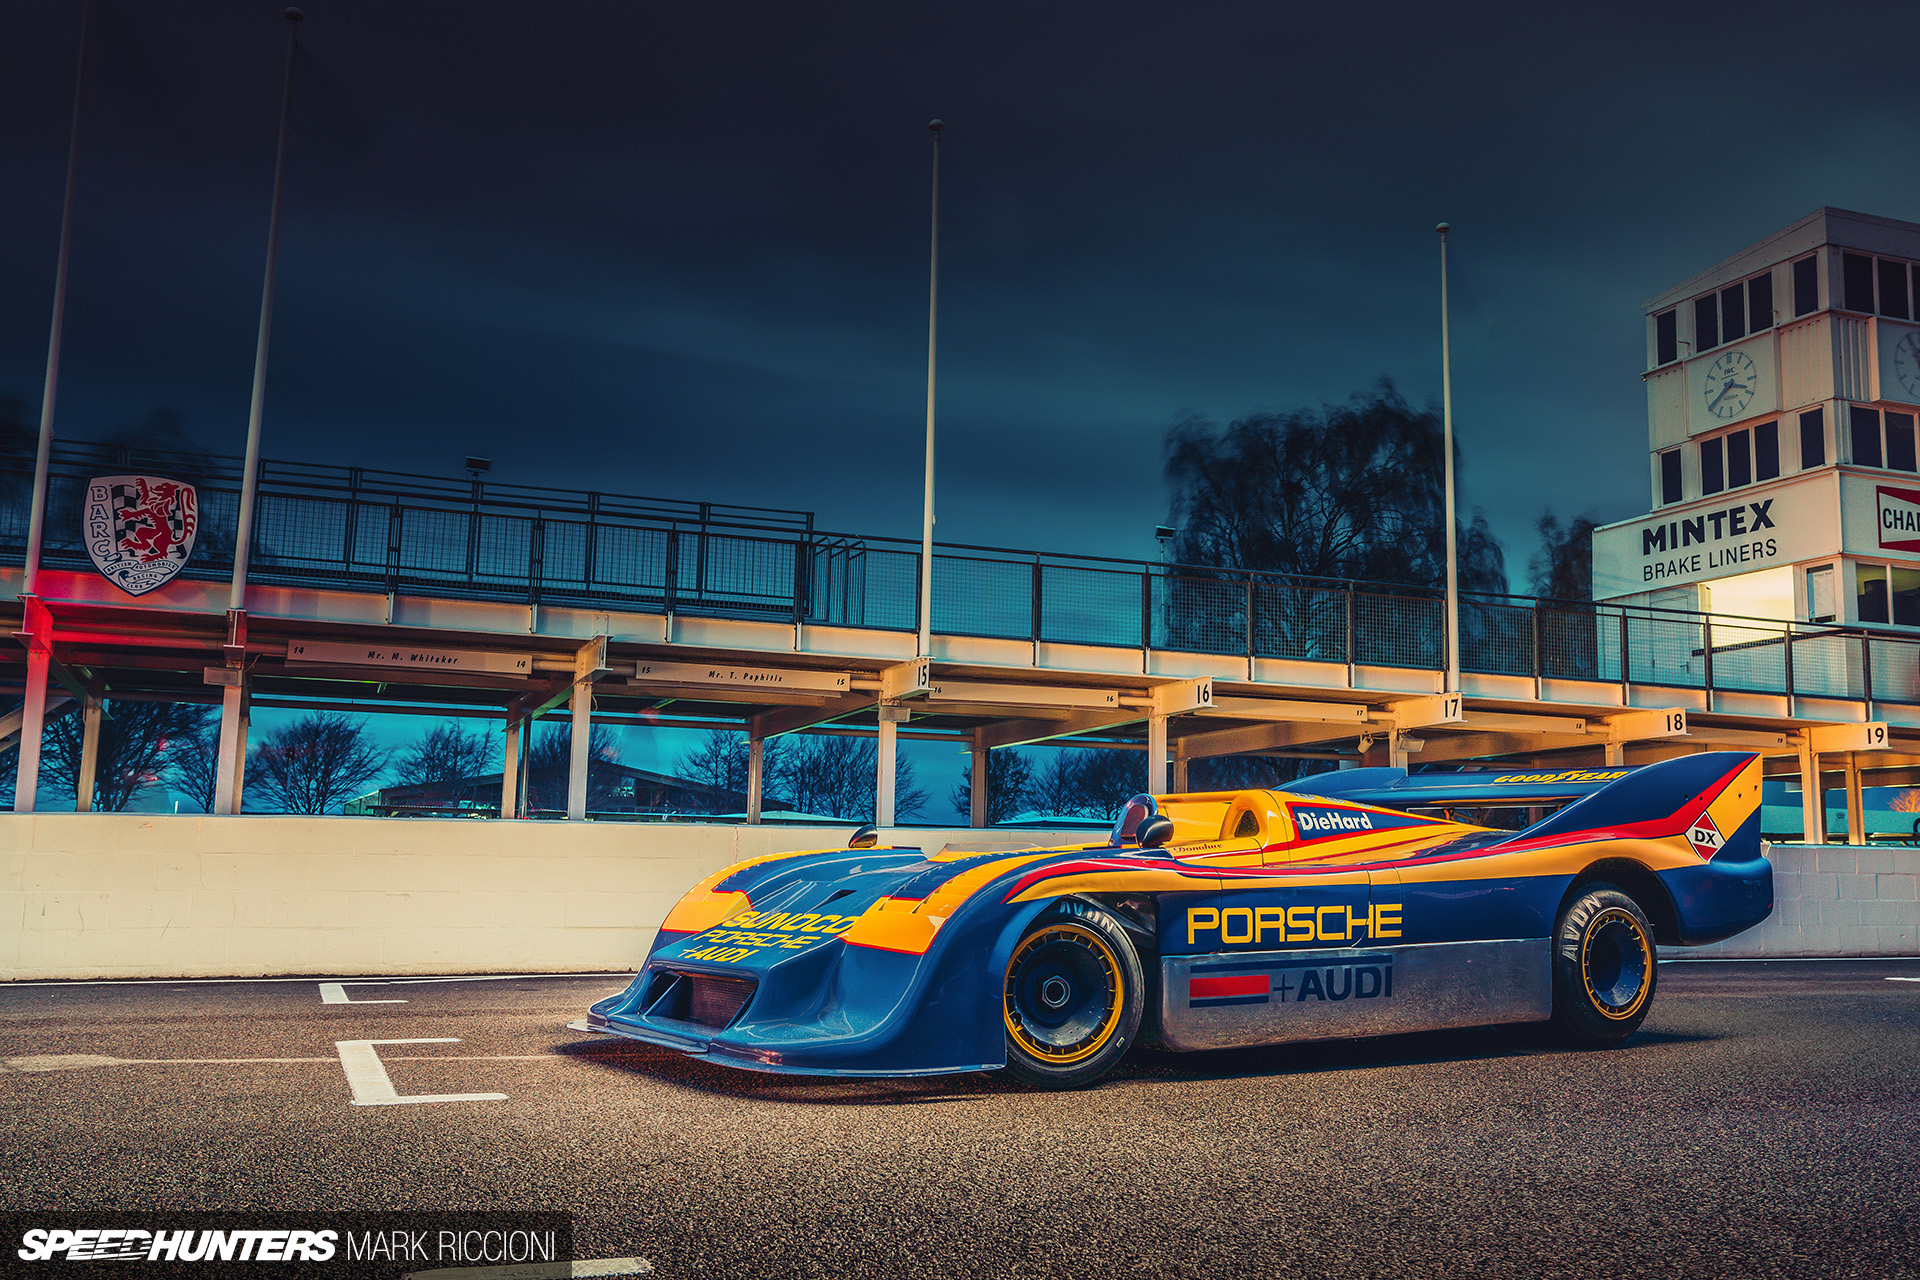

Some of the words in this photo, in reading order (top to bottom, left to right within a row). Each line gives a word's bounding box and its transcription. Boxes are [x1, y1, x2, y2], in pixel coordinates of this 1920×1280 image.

[90, 485, 110, 557] BARC
[1642, 498, 1775, 556] MINTEX
[1882, 507, 1920, 532] CHA
[106, 562, 132, 573] BRITISH
[135, 562, 175, 570] AUTOMOBILE
[1643, 554, 1702, 582] BRAKE
[1708, 538, 1777, 569] LINERS
[132, 573, 158, 581] RACING
[294, 646, 304, 655] 14
[367, 650, 385, 660] Mr.
[391, 651, 403, 661] M.
[516, 660, 526, 669] 14
[642, 666, 651, 674] 15
[708, 670, 723, 680] Mr.
[730, 671, 738, 680] T.
[743, 672, 783, 683] Paphitis
[836, 678, 845, 686] 15
[917, 664, 928, 687] 15
[933, 686, 942, 694] 16
[1106, 695, 1114, 703] 16
[1197, 684, 1210, 704] 16
[1445, 698, 1459, 718] 17
[1666, 713, 1683, 732] 18
[1866, 727, 1884, 745] 19
[1493, 769, 1628, 784] GOODYEAR
[1297, 812, 1373, 831] DieHard
[1694, 829, 1716, 846] DX
[721, 910, 862, 934] SUNOCO
[1187, 903, 1403, 945] PORSCHE
[1561, 892, 1602, 963] AVON
[692, 929, 822, 949] PORSCHE
